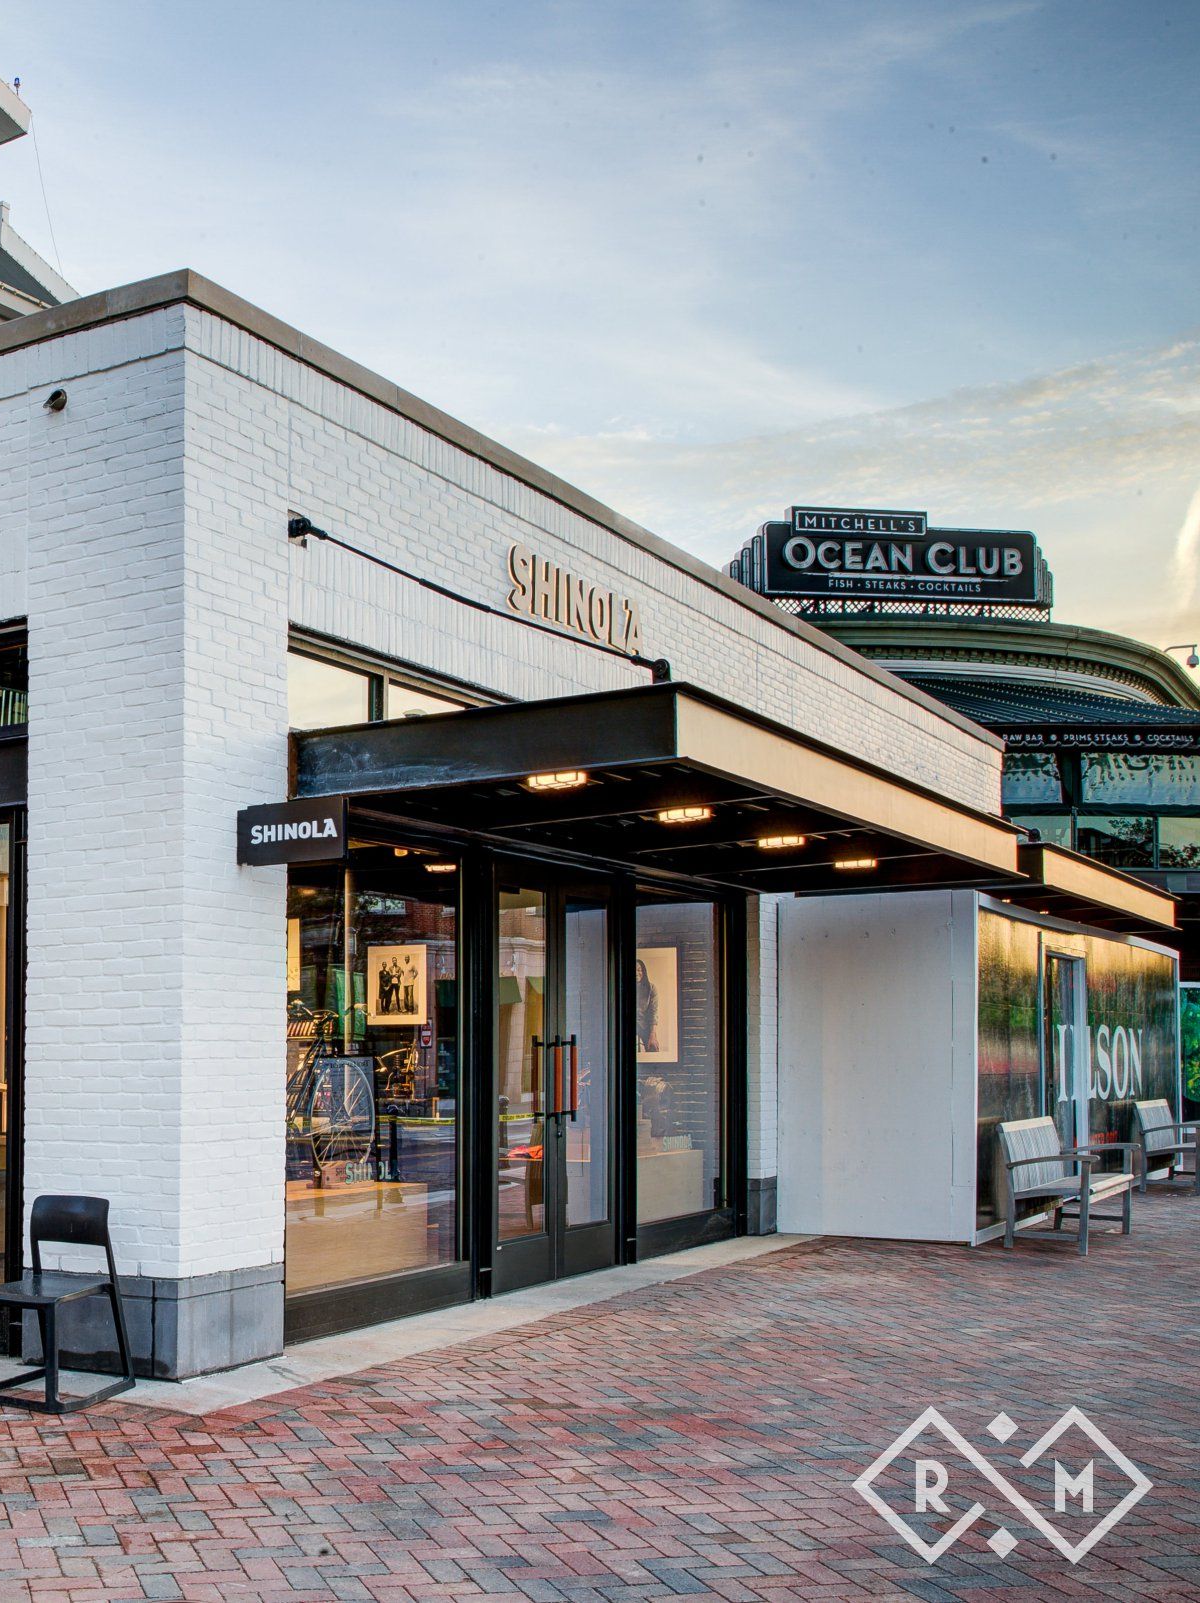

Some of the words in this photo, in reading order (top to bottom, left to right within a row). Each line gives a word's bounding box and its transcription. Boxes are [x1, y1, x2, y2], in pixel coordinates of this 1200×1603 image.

[803, 514, 917, 532] MITCHELL'S
[783, 536, 914, 573] OCEAN
[925, 541, 1023, 577] CLUB
[828, 578, 854, 589] FISH
[865, 580, 907, 591] STEAKS
[917, 582, 982, 593] COCKTAILS
[506, 542, 644, 656] SHINOLA
[1002, 733, 1022, 742] RAW
[1025, 733, 1044, 742] BAR
[1063, 733, 1092, 742] PRIME
[1094, 733, 1129, 742] STEAKS
[1147, 734, 1195, 743] COCKTAILS
[250, 817, 339, 845] SHINOLA
